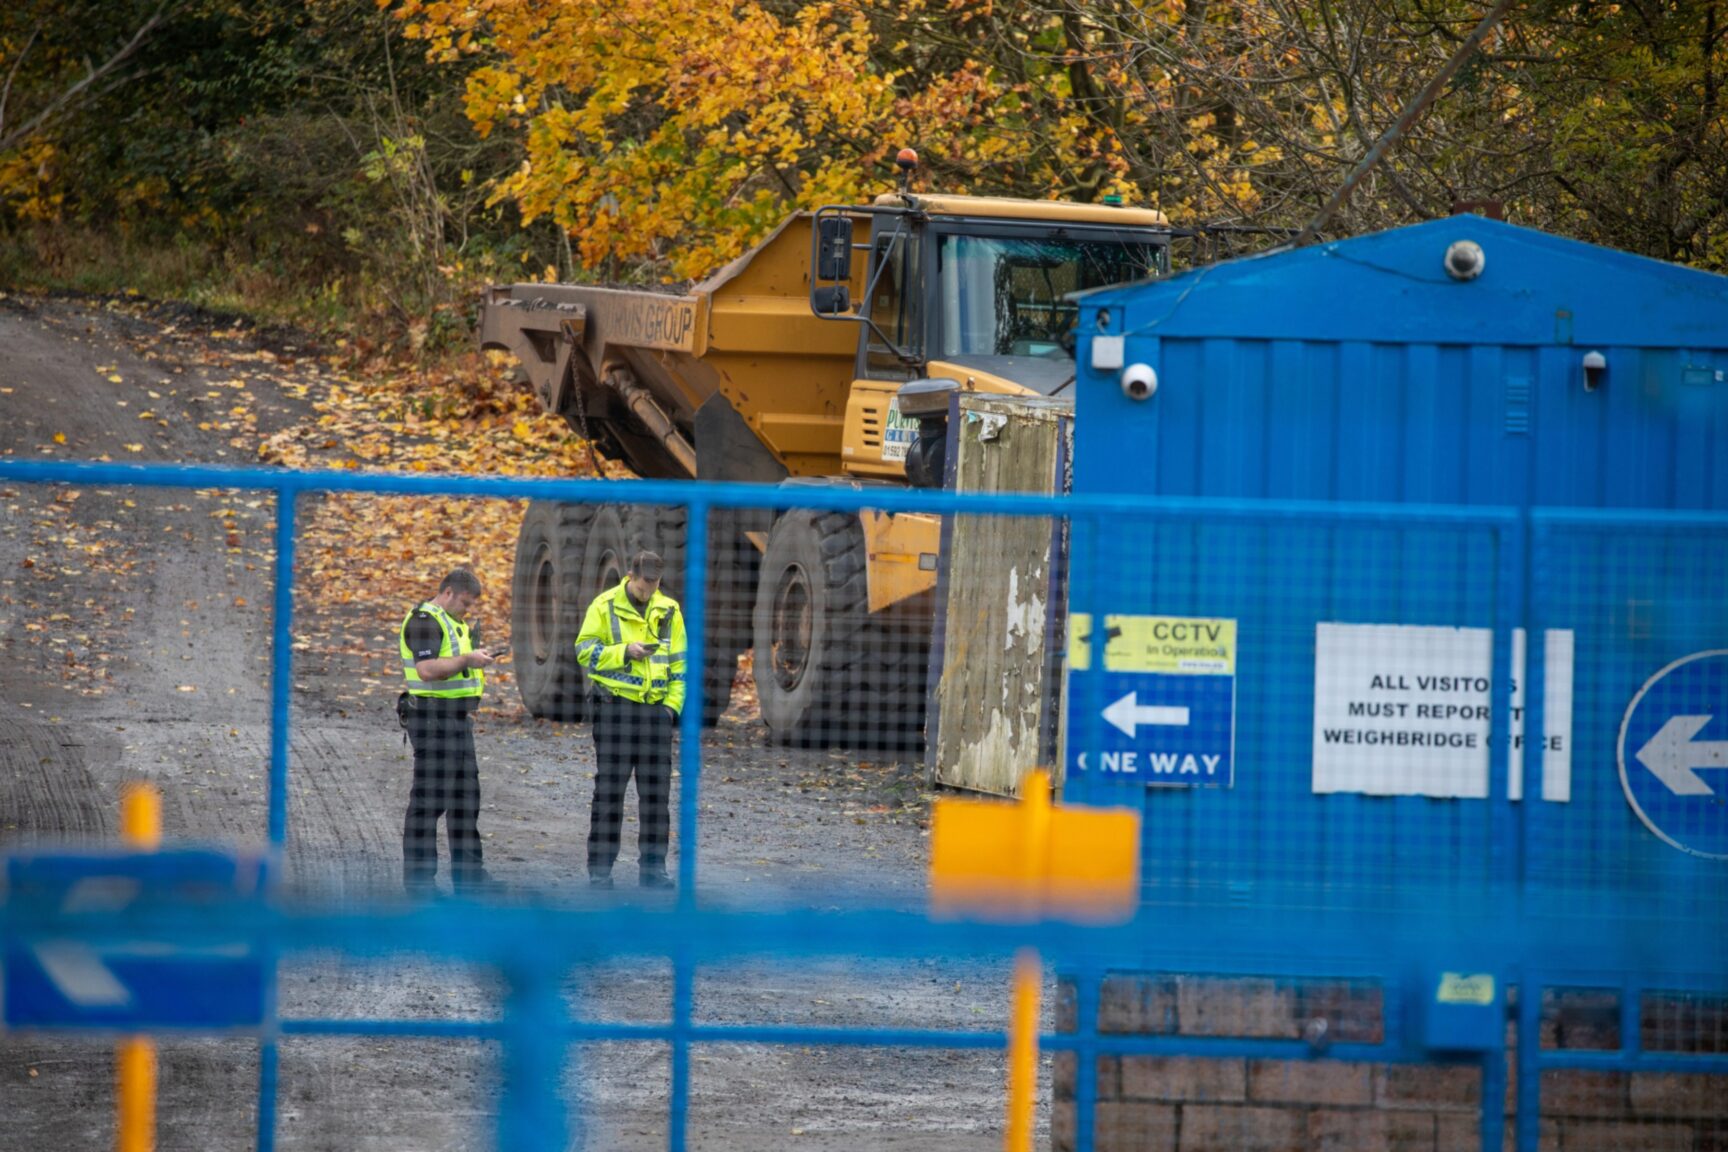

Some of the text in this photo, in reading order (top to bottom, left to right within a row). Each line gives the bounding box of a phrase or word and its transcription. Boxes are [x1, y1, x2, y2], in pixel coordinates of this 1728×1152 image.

[645, 303, 693, 345] GROUP
[1153, 622, 1221, 642] CCTV
[1146, 645, 1160, 655] In
[1370, 675, 1518, 693] ALL VISITOS
[1348, 702, 1409, 718] MUST
[1416, 704, 1491, 721] REPOR
[1324, 729, 1477, 748] WEIGHBRIDGE
[1149, 752, 1221, 775] WAY
